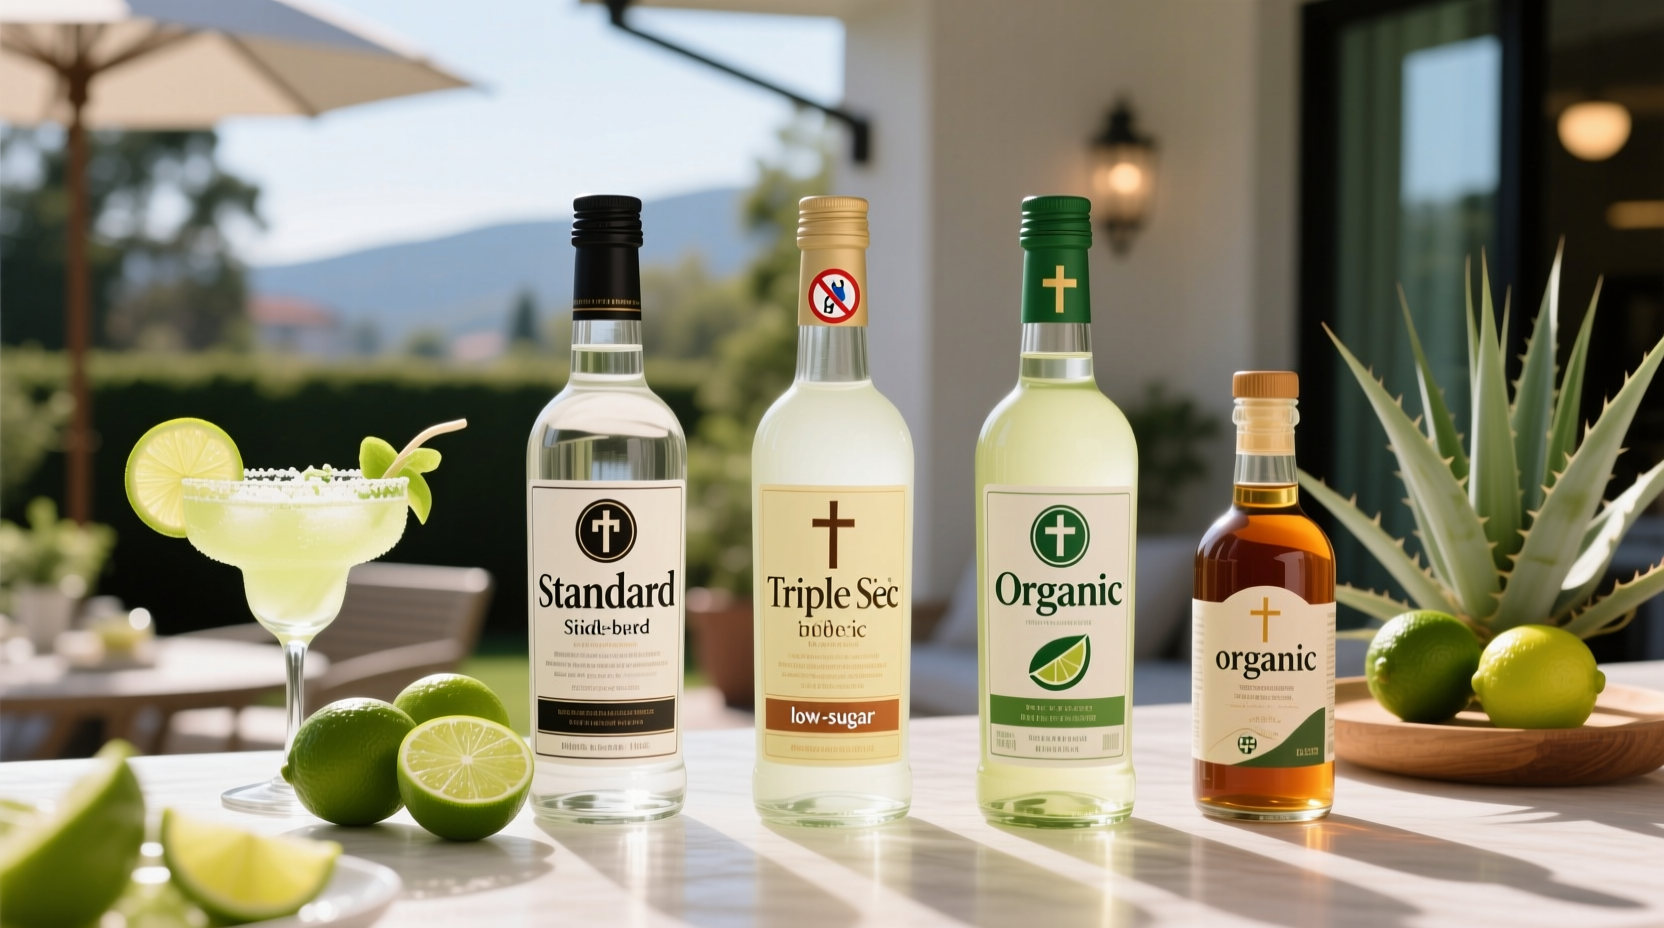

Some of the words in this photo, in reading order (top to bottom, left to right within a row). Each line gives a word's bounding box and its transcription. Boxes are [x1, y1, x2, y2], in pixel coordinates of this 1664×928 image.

[539, 569, 675, 609] Standard
[767, 576, 851, 618] Triple
[995, 571, 1123, 617] Organic
[1215, 643, 1317, 680] organic
[791, 706, 876, 730] low-sugar
